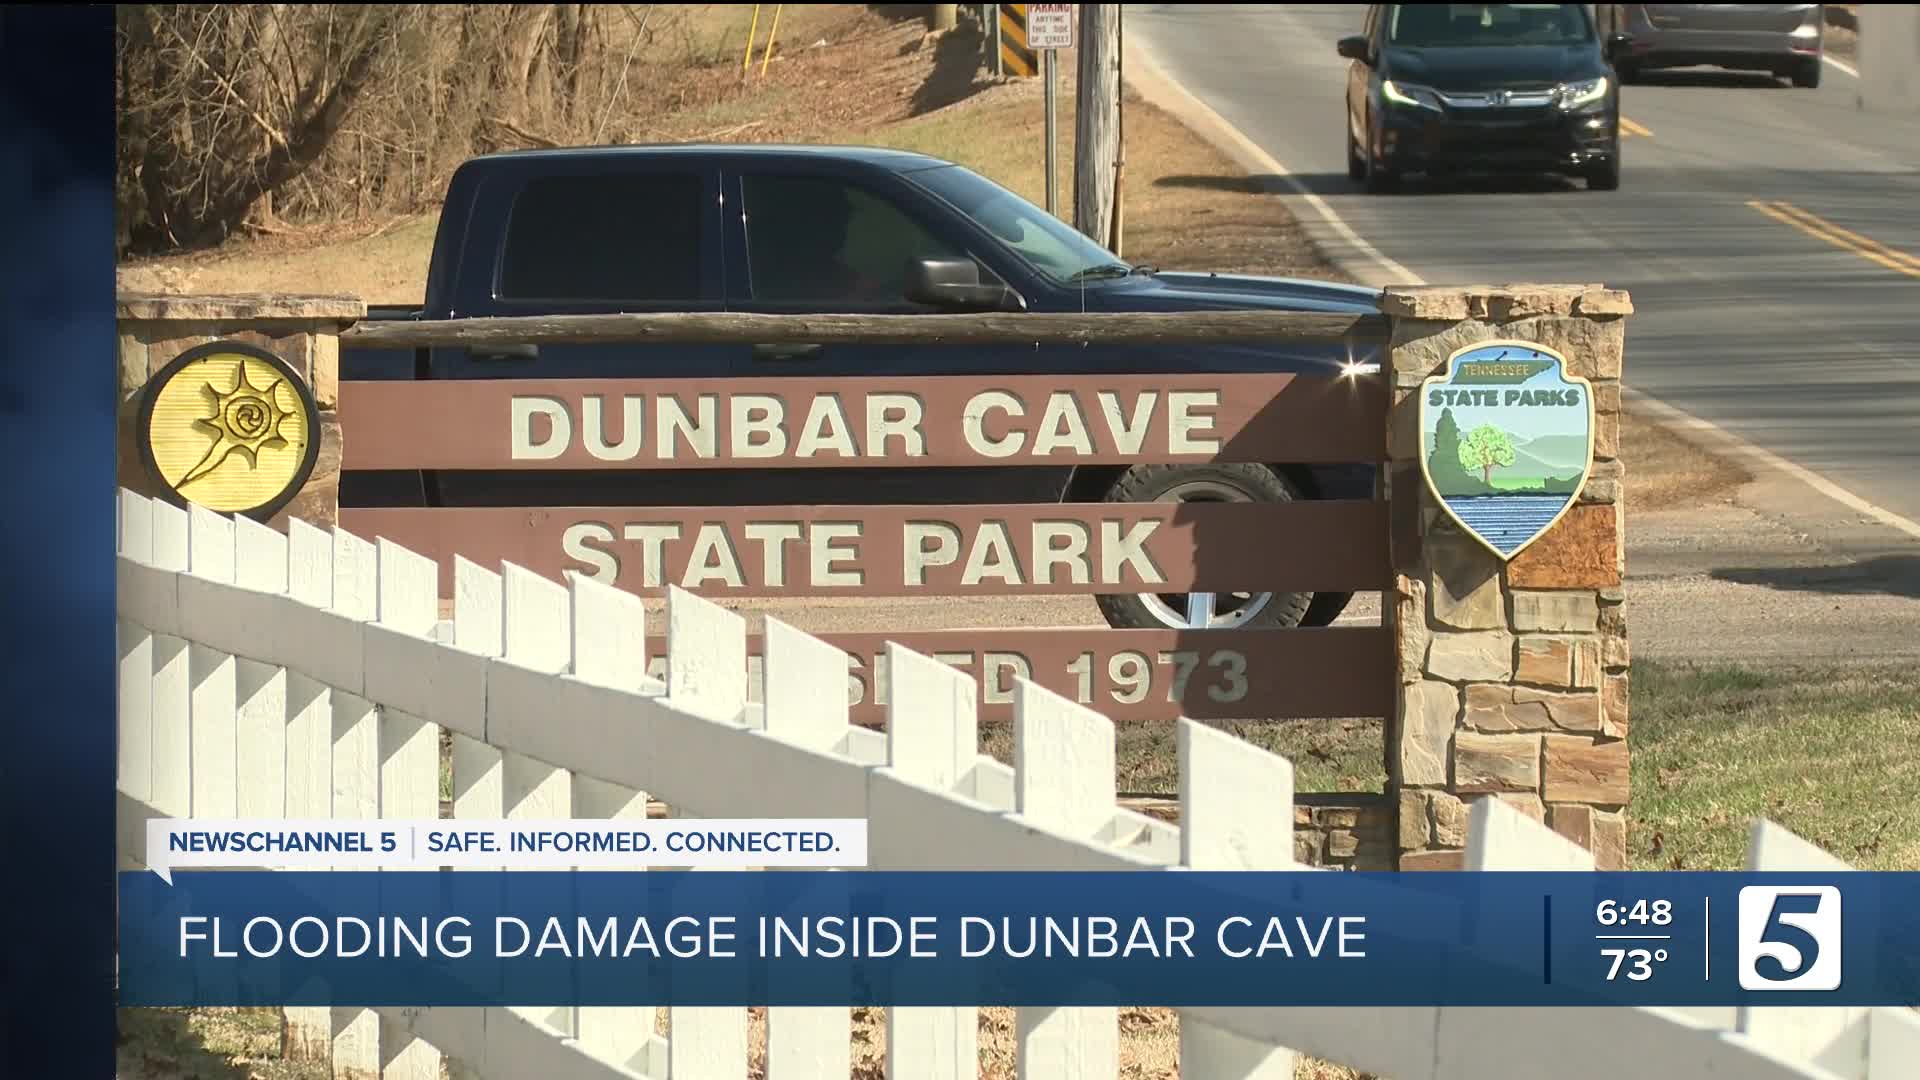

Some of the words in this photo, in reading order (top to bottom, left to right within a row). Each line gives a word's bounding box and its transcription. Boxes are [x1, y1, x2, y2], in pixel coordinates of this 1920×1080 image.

[1463, 363, 1529, 376] TENNESSEE
[1428, 389, 1499, 407] STATE
[1504, 389, 1580, 407] PARKS
[510, 393, 926, 462] DUNBAR
[963, 390, 1222, 458] CAVE
[561, 521, 867, 588] STATE
[904, 520, 1170, 587] PARK
[1066, 650, 1249, 704] 1973
